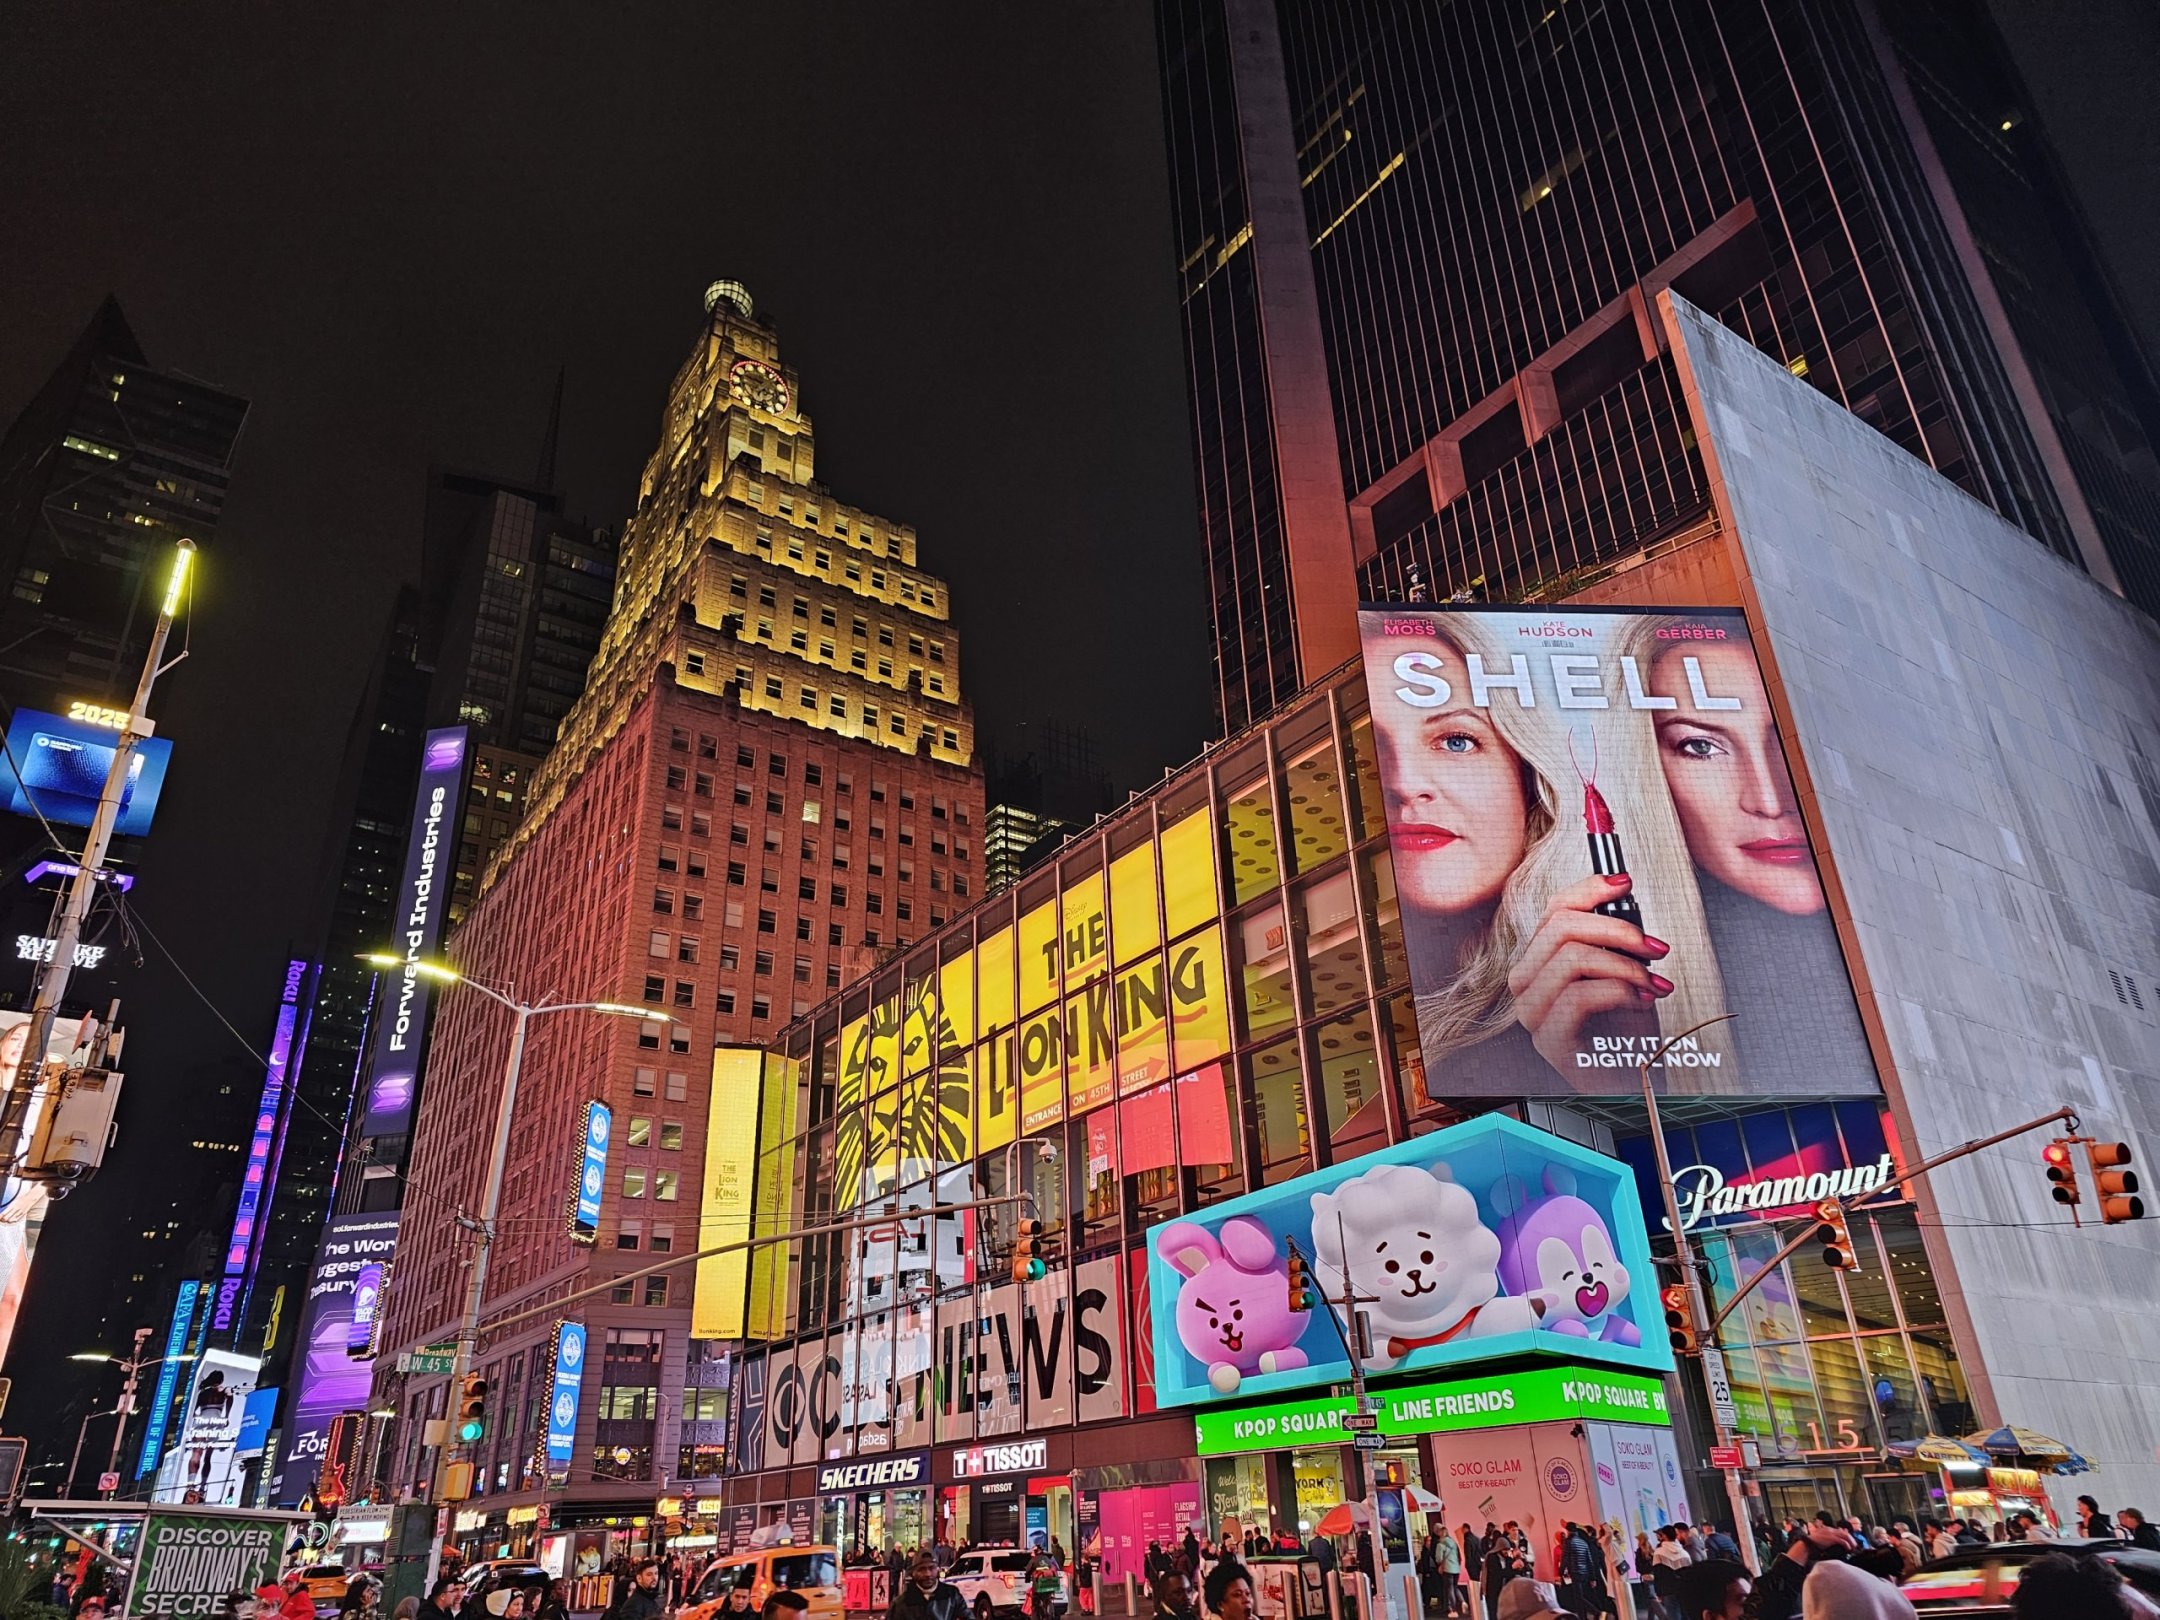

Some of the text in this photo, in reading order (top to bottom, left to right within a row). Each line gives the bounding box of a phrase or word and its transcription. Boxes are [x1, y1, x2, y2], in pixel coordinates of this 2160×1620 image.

[1384, 625, 1437, 636] MOSS
[1518, 627, 1593, 638] HUDSON
[1655, 629, 1728, 640] GERBER
[1392, 651, 1743, 711] SHELL
[68, 701, 131, 730] 2025
[409, 786, 446, 926] Industries
[1042, 911, 1105, 981] THE
[389, 928, 424, 1051] Forward
[989, 946, 1207, 1119] LION KING
[1593, 1036, 1698, 1051] BUY IT ON
[1576, 1053, 1721, 1067] DIGITAL NOW
[1025, 1104, 1062, 1127] ENTRANCE
[1072, 1094, 1086, 1106] ON
[1089, 1083, 1111, 1100] 45TH
[1121, 1066, 1149, 1086] STREET
[722, 1164, 737, 1172] THE
[718, 1174, 738, 1187] LION
[714, 1186, 740, 1201] KING
[1661, 1153, 1895, 1233] Paramount
[698, 1328, 736, 1336] lionking.com
[164, 1322, 186, 1373] ALZHEIMR'S
[916, 1288, 1112, 1423] NEWS
[412, 1356, 424, 1371] W
[427, 1358, 442, 1372] 45
[151, 1374, 175, 1426] FOUNDATION
[730, 1373, 741, 1421] NEWS
[1713, 1380, 1729, 1402] 25
[1234, 1417, 1276, 1439] KPOP
[1393, 1400, 1433, 1421] LINE
[1436, 1388, 1516, 1417] FRIENDS
[1562, 1381, 1602, 1406] KPOP
[1604, 1386, 1650, 1410] SQUARE
[149, 1427, 161, 1438] OF
[1347, 1419, 1357, 1427] ONE
[1617, 1441, 1653, 1456] SOKO GLAM
[259, 1438, 278, 1486] SQUARE
[1450, 1459, 1522, 1477] SOKO GLAM
[819, 1456, 921, 1491] SKECHERS
[1458, 1478, 1516, 1489] BEST OF K-BEAUTY
[1174, 1501, 1197, 1512] FLAGSHIP
[1175, 1512, 1191, 1522] RETAIL
[158, 1527, 273, 1547] DISCOVER
[145, 1545, 269, 1594] BROADWAY'S
[139, 1594, 230, 1615] SECRE
